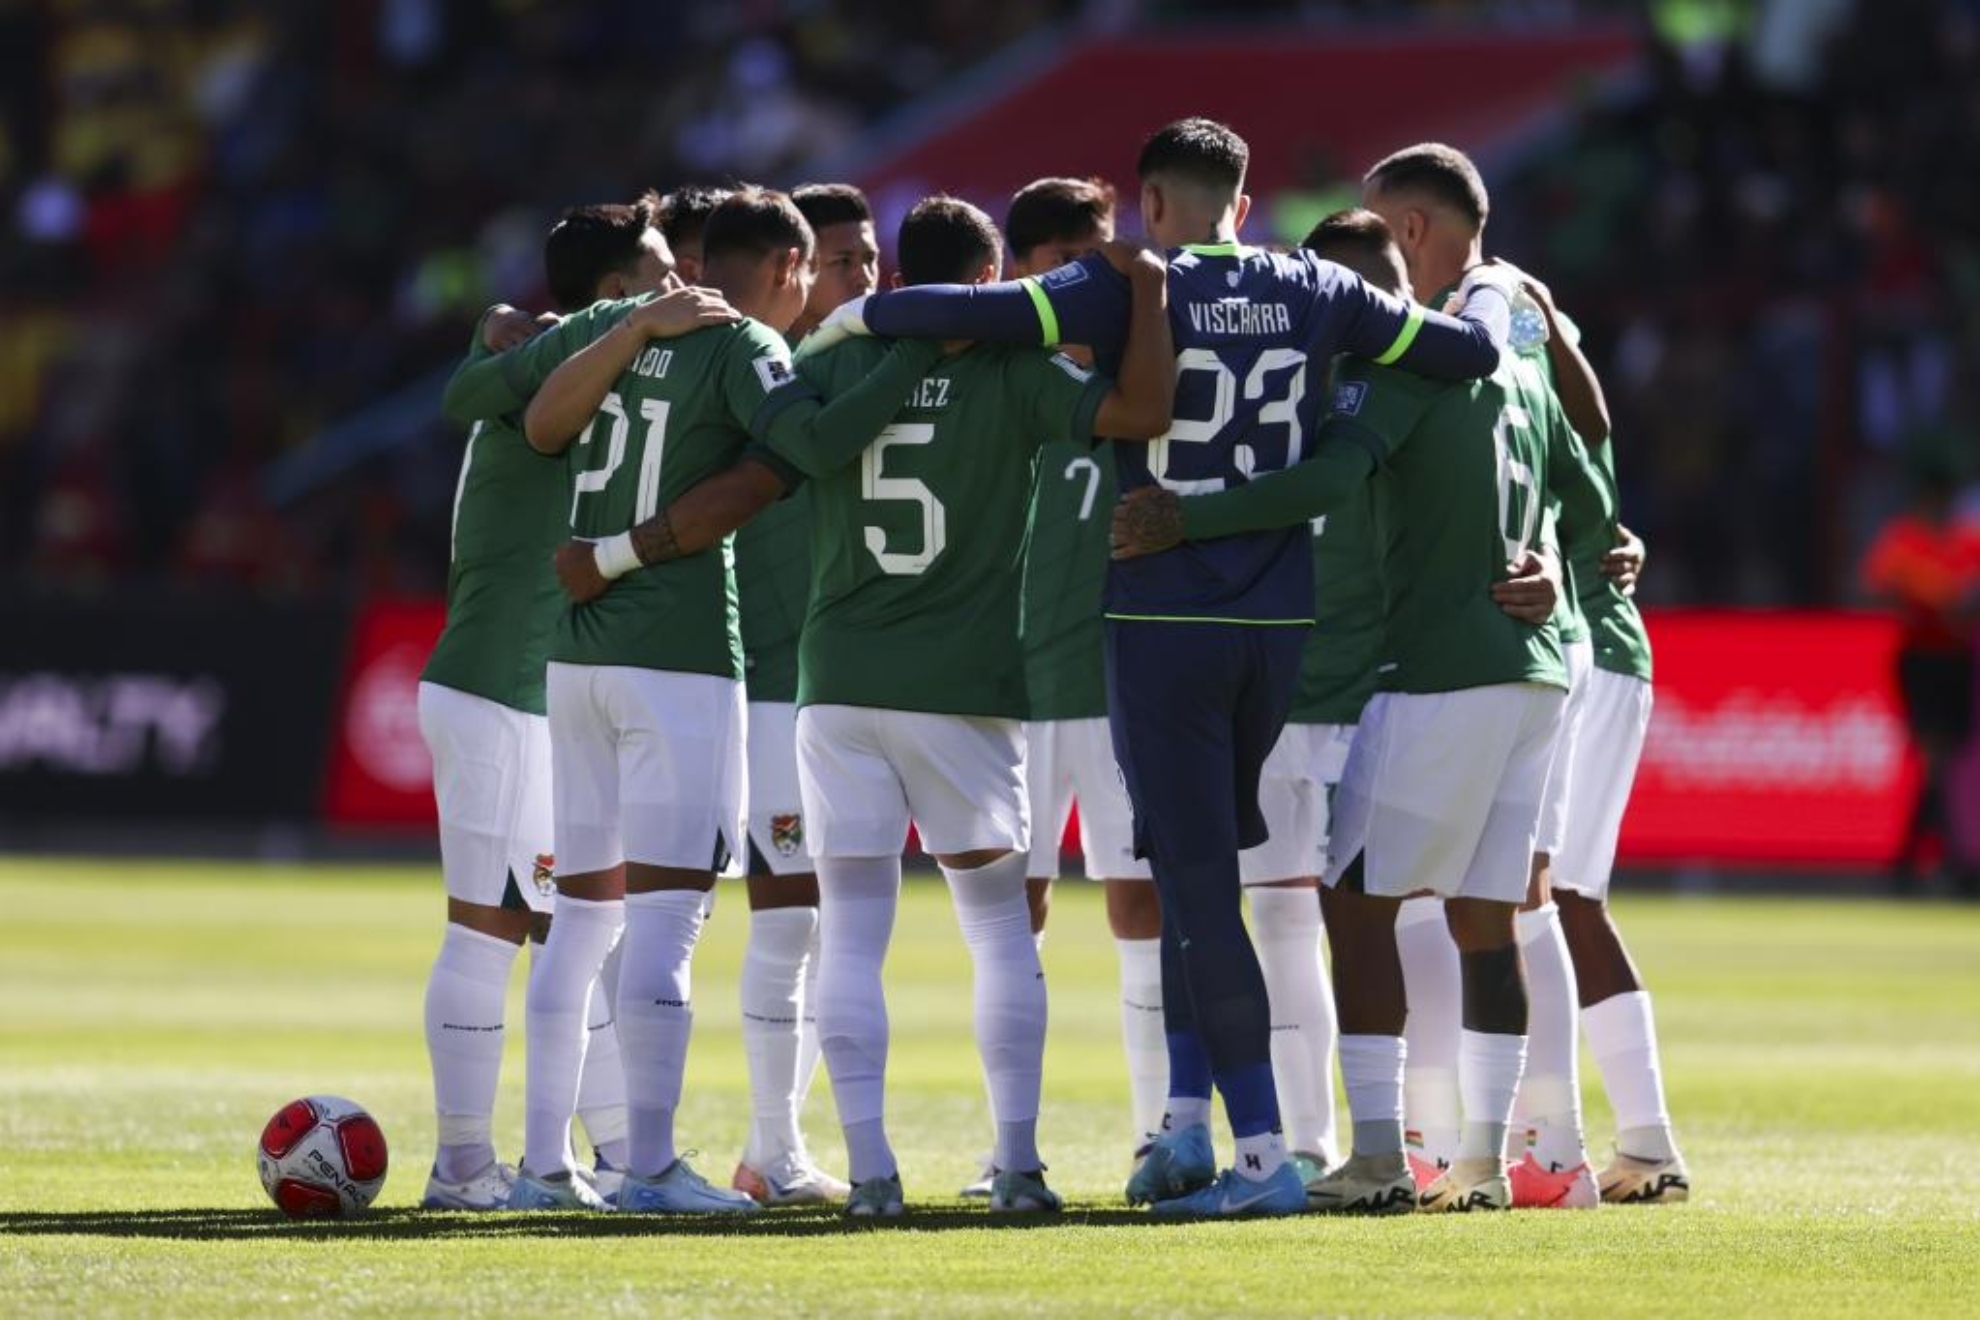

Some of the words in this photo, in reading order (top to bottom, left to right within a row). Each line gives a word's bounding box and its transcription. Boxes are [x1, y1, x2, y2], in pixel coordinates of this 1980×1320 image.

[1188, 302, 1291, 335] VISCARRA
[569, 392, 671, 527] 21
[1065, 457, 1100, 520] 7
[1147, 348, 1308, 496] 23
[1493, 404, 1538, 562] 6
[861, 423, 946, 575] 5
